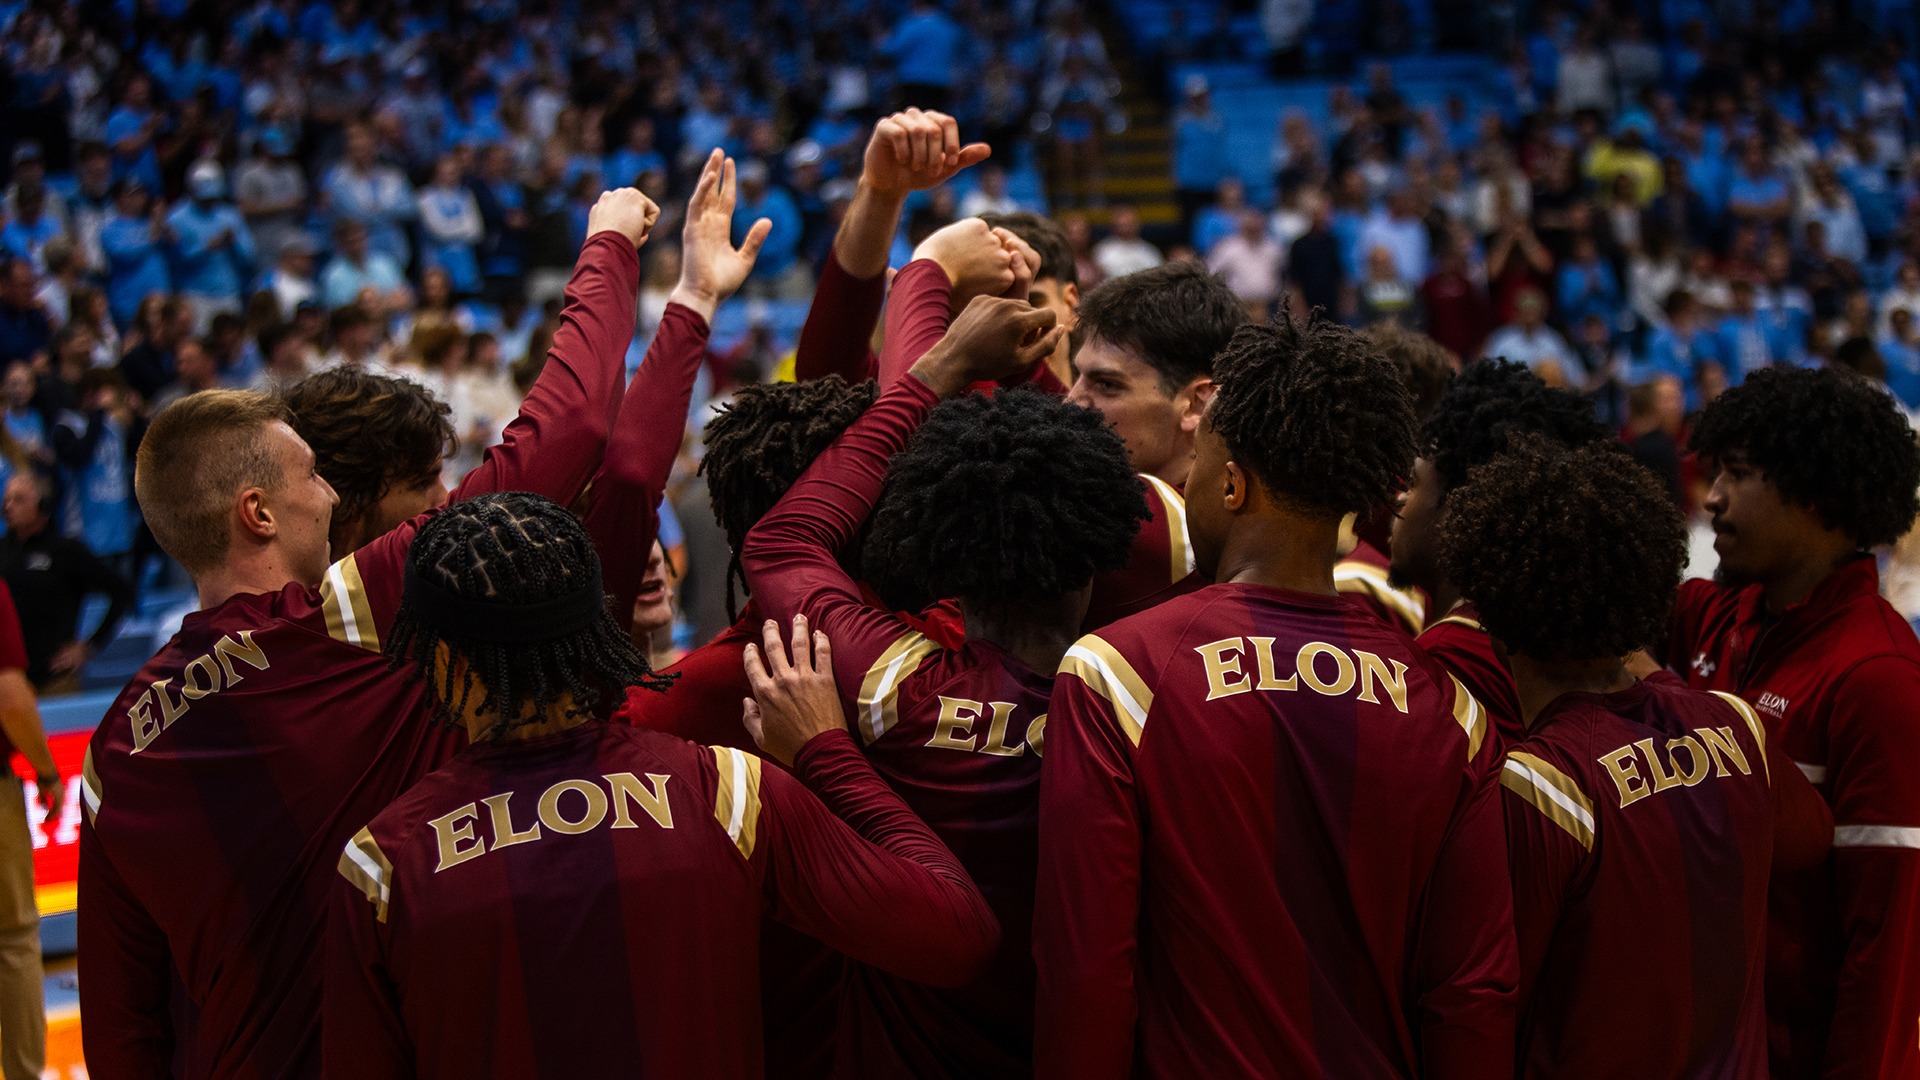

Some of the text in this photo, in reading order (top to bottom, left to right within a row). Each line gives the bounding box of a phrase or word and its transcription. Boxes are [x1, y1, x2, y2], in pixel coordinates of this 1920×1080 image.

[127, 630, 271, 755] ELON
[1193, 636, 1410, 714] ELON
[1758, 692, 1789, 713] ELON
[1598, 726, 1752, 809] ELON
[427, 772, 674, 873] ELON
